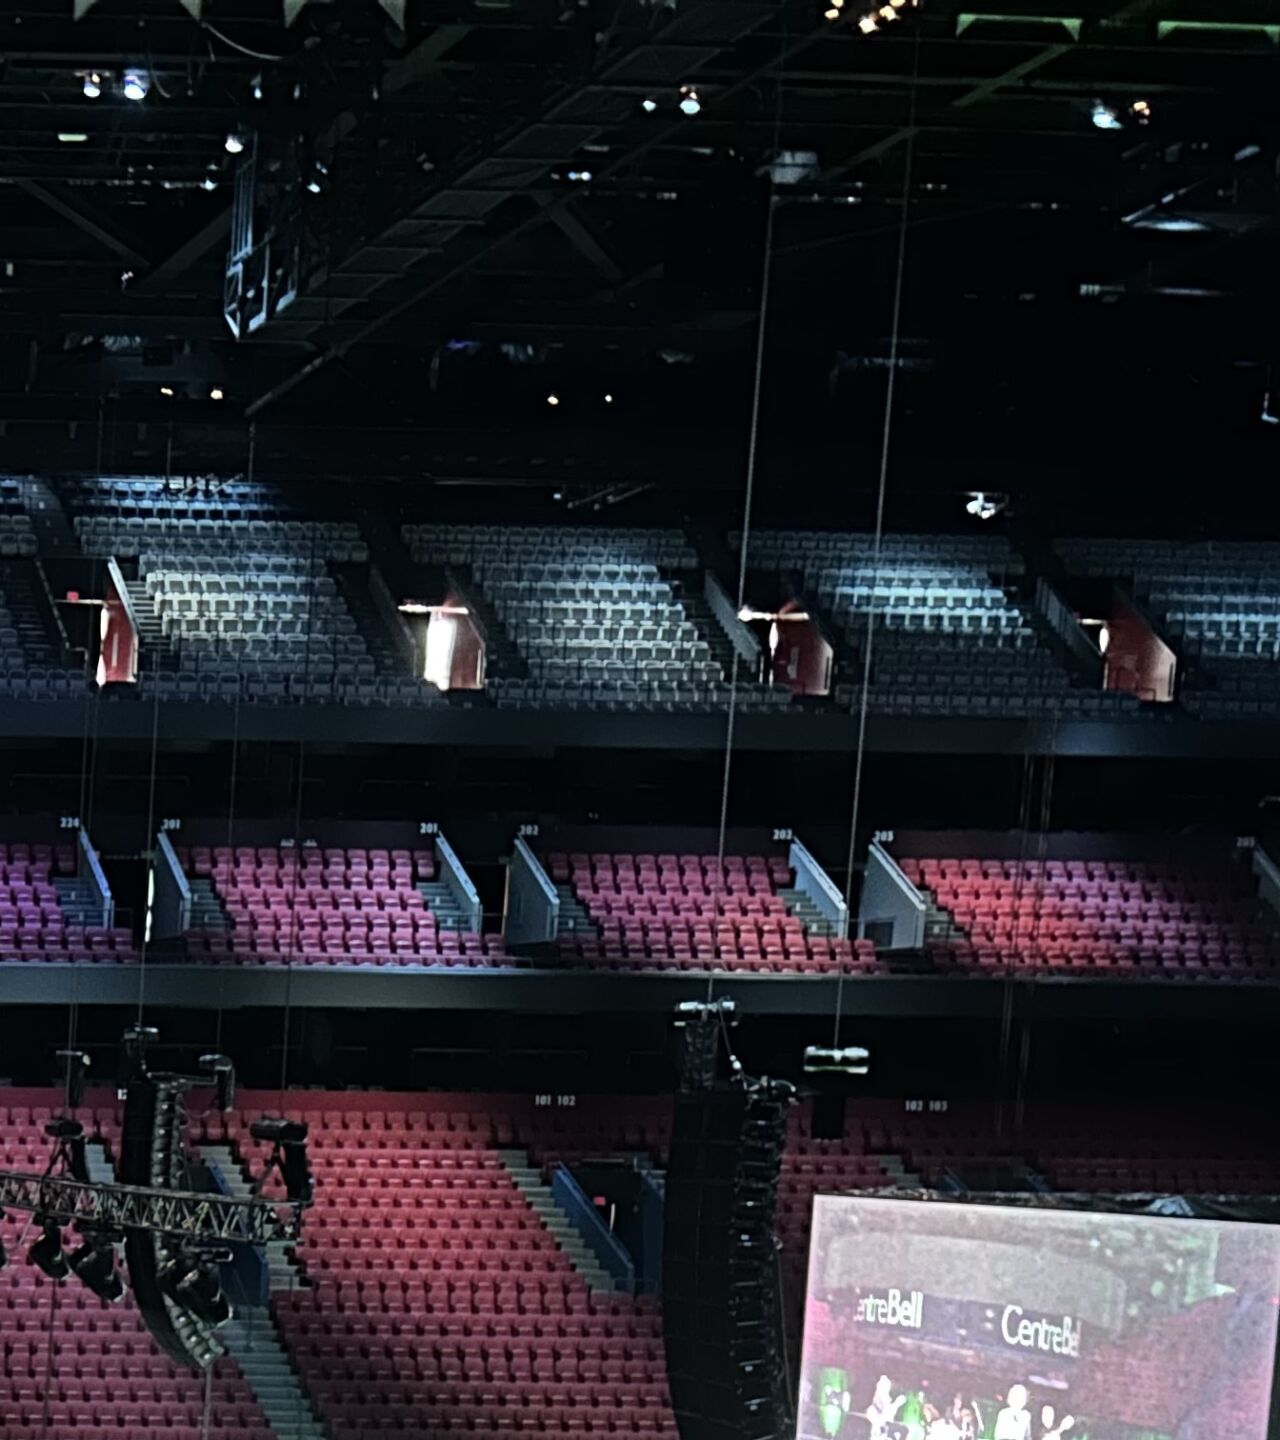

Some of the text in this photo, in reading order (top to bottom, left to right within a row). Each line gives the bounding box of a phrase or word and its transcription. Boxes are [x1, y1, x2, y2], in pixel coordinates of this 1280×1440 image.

[162, 818, 181, 830] 201
[420, 822, 438, 834] 201
[535, 1094, 576, 1106] 101 102
